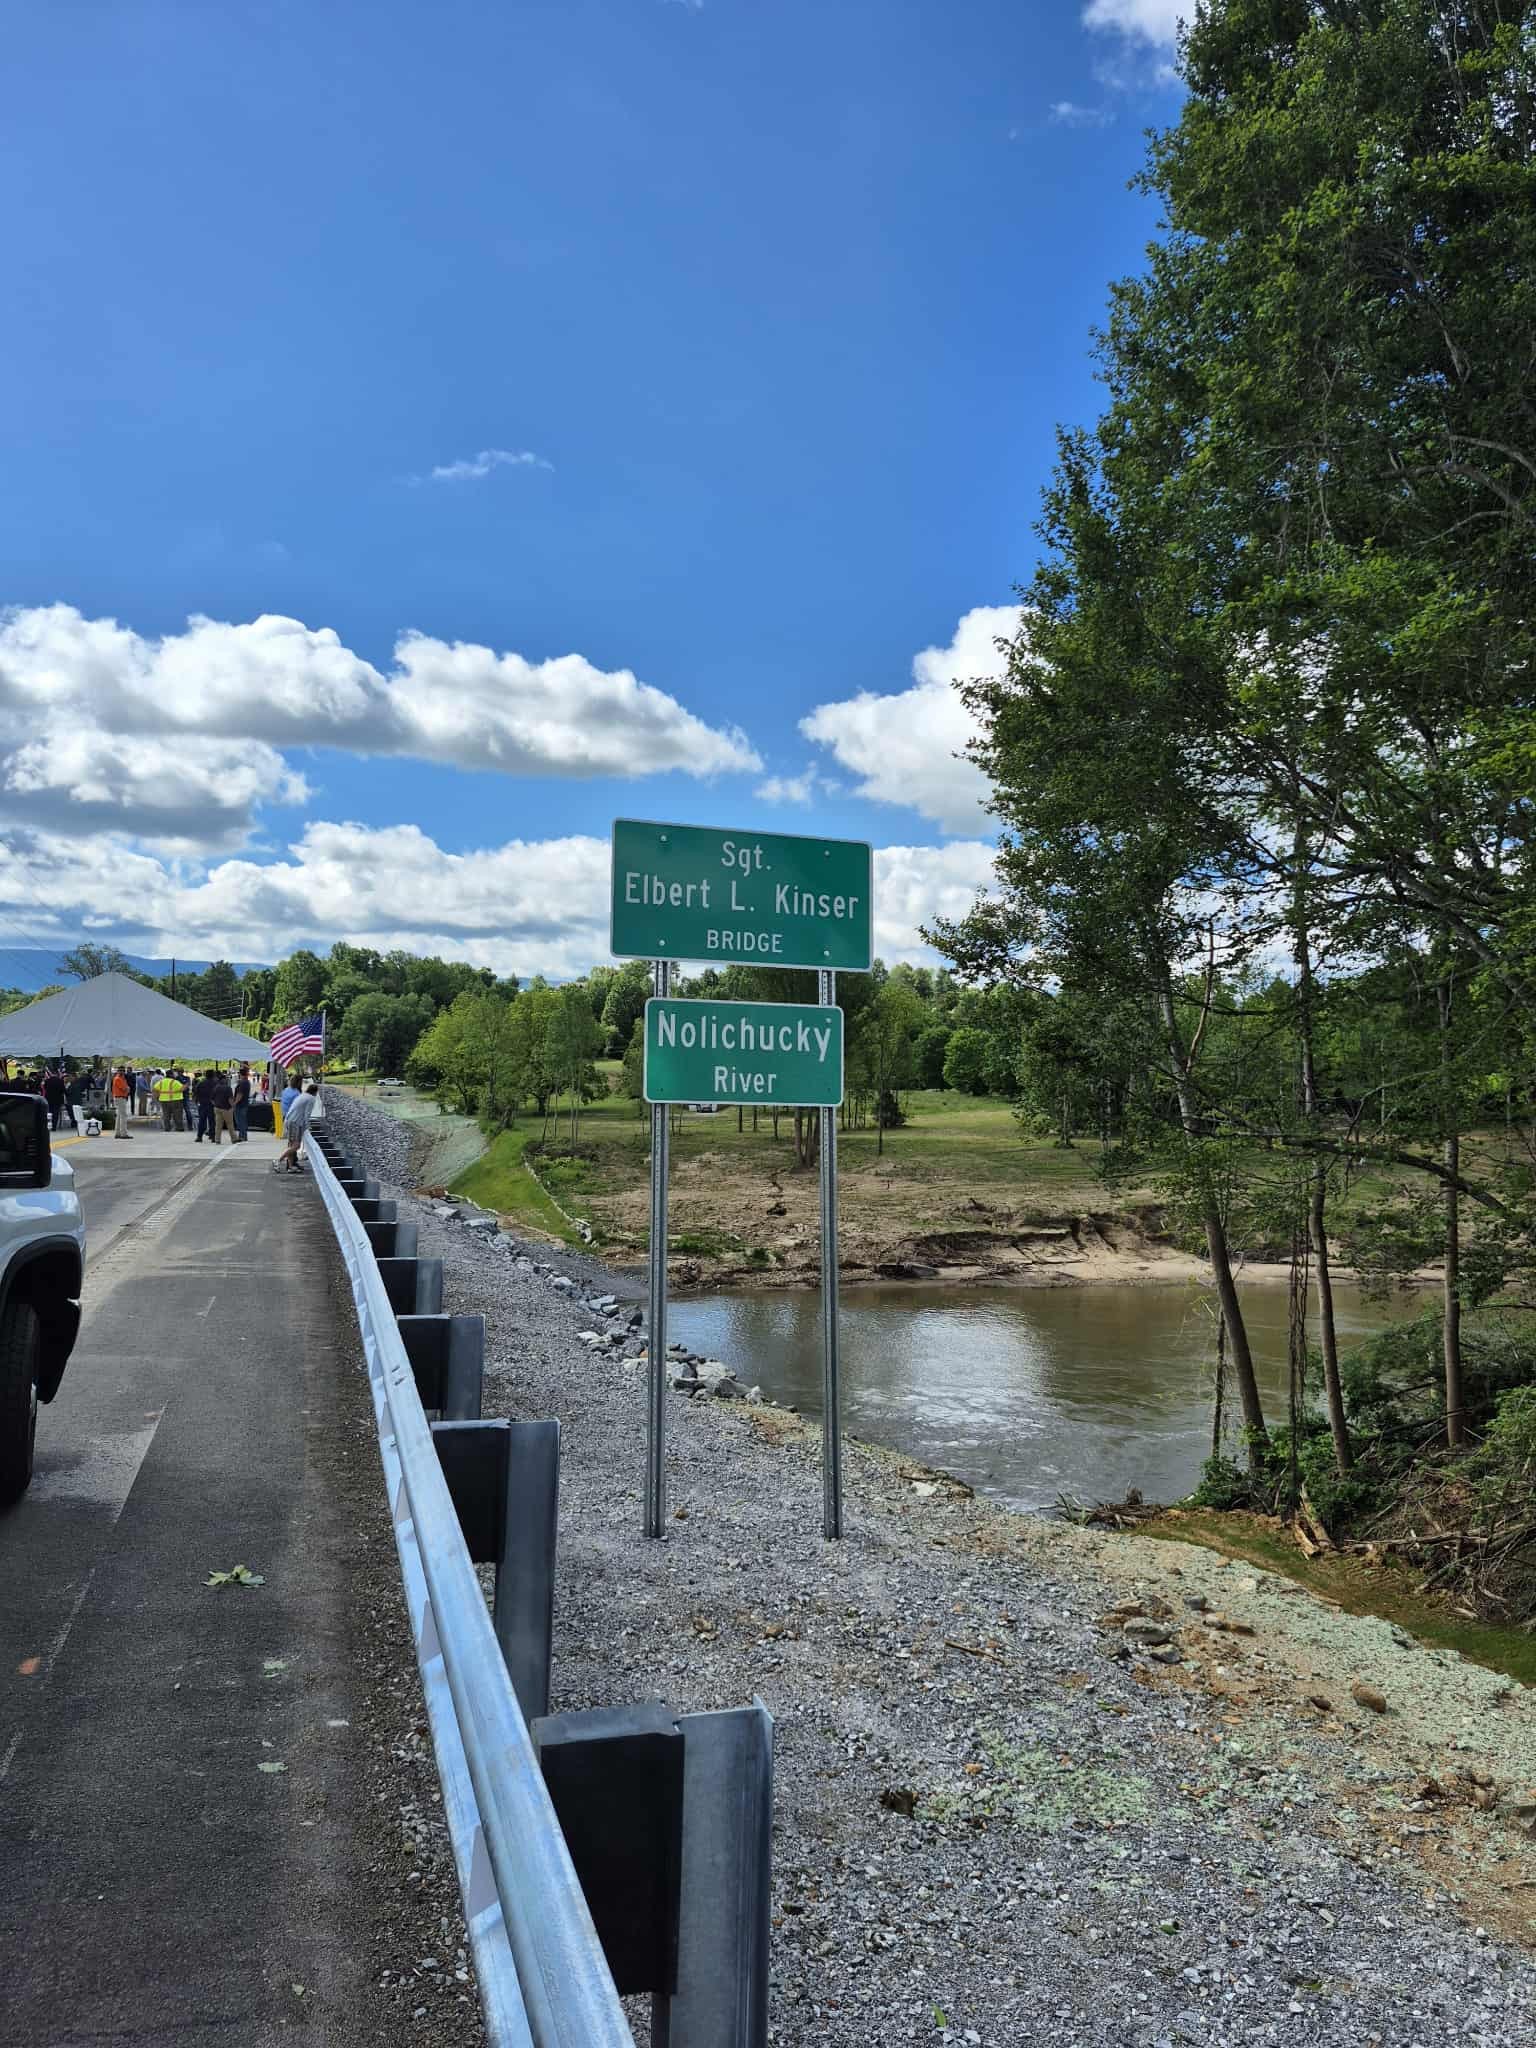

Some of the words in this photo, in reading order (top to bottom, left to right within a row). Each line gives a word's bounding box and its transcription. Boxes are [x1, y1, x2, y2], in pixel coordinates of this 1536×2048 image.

[721, 841, 772, 877] Sgt.
[625, 872, 711, 909] Elbert
[730, 881, 755, 912] L.
[775, 884, 859, 919] Kinser
[706, 929, 784, 953] BRIDGE
[657, 1009, 832, 1062] Nolichucky
[713, 1066, 777, 1094] River
